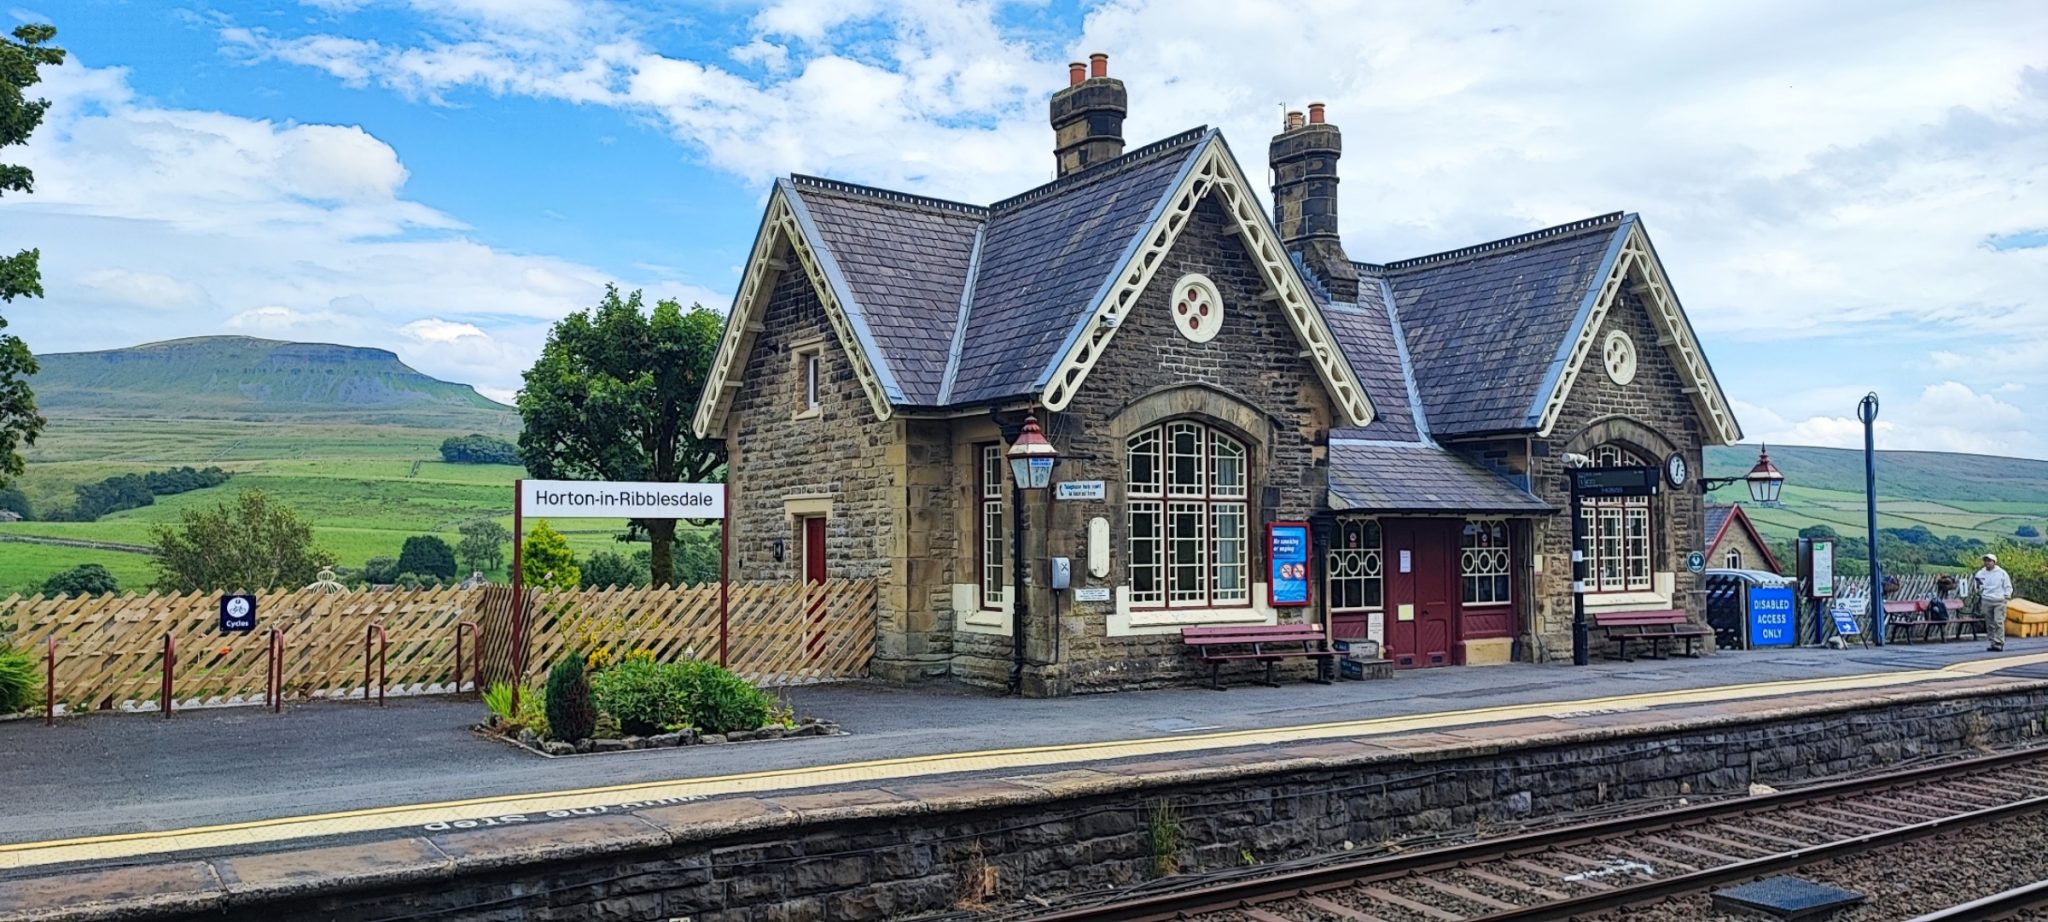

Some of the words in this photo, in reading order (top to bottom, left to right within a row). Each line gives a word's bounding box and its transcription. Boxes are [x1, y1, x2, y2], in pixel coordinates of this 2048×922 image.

[535, 490, 713, 506] Horton-in-Ribblesdale
[1754, 599, 1789, 610] DISABLED
[226, 620, 248, 628] Cycles
[1757, 614, 1786, 624] ACCESS
[1762, 628, 1782, 639] ONLY
